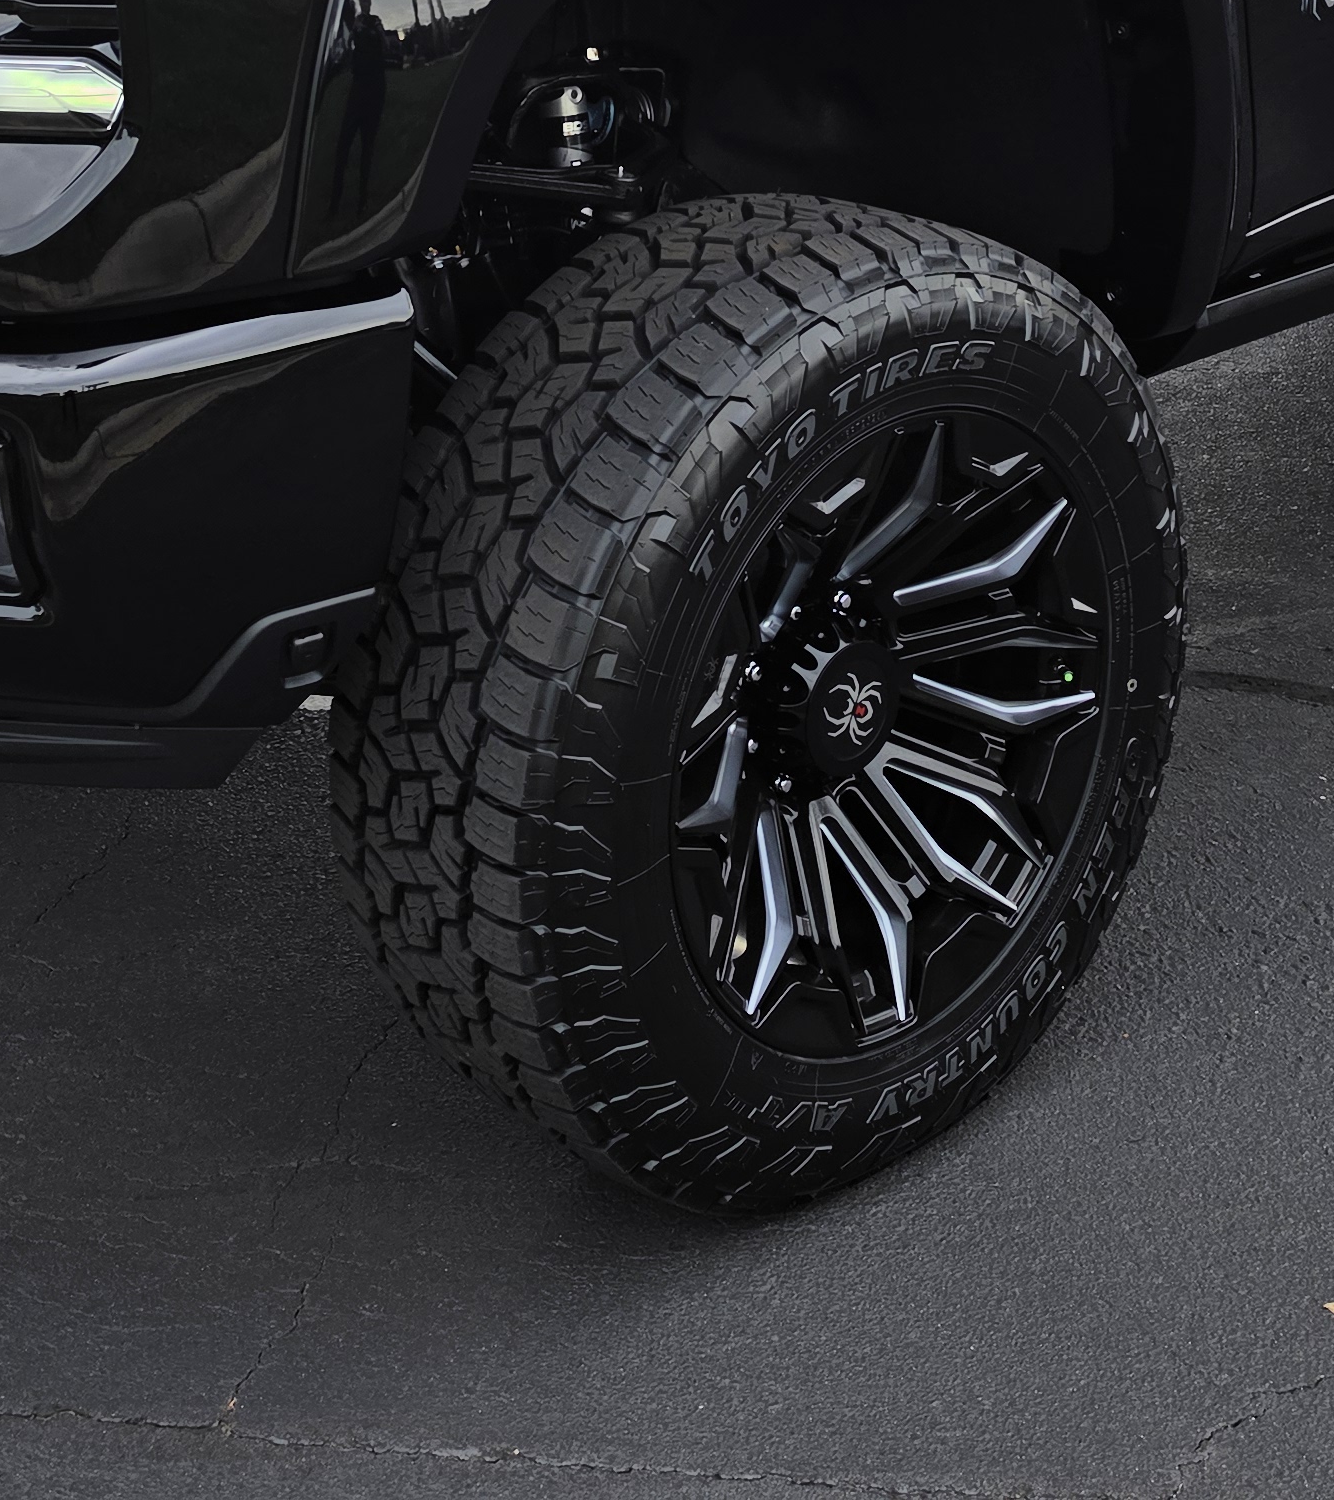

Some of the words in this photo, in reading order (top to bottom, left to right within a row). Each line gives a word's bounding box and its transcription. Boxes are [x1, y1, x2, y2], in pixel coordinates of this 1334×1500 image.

[689, 408, 817, 581] TOYO
[828, 340, 996, 417] TIRES
[865, 920, 1069, 1125] COUNTRY
